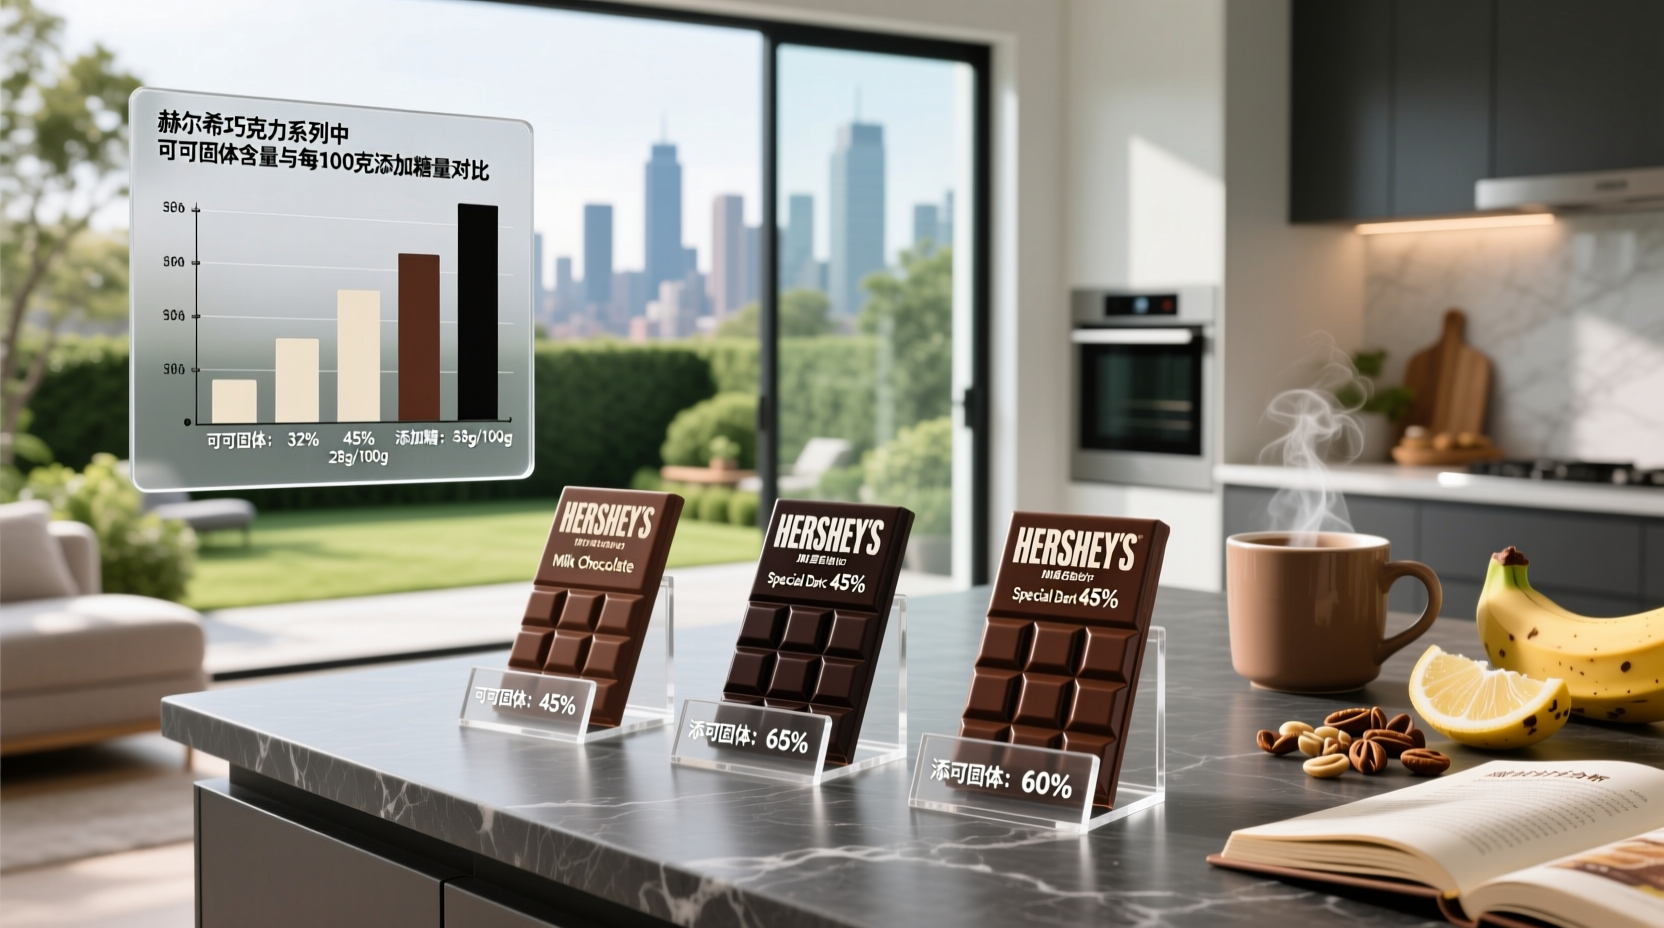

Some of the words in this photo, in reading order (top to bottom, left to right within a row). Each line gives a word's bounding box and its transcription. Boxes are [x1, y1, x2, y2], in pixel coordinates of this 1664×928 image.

[157, 109, 349, 145] 赫尔希巧克力系列中
[158, 138, 490, 181] 可可固体含量与每100克添加糖量对比
[287, 432, 320, 447] 32%
[343, 430, 375, 446] 45%
[559, 501, 655, 539] HERSHEY'S
[773, 513, 885, 556] HERSHEY'S
[1012, 526, 1138, 571] HERSHEY'S
[552, 553, 575, 568] Milk
[578, 555, 634, 574] Chocolate
[829, 572, 866, 594] 45%
[1011, 586, 1053, 604] Special
[1079, 587, 1119, 609] 45%
[538, 692, 576, 715] 45%
[765, 727, 809, 754] 65%
[1021, 769, 1073, 799] 60%
